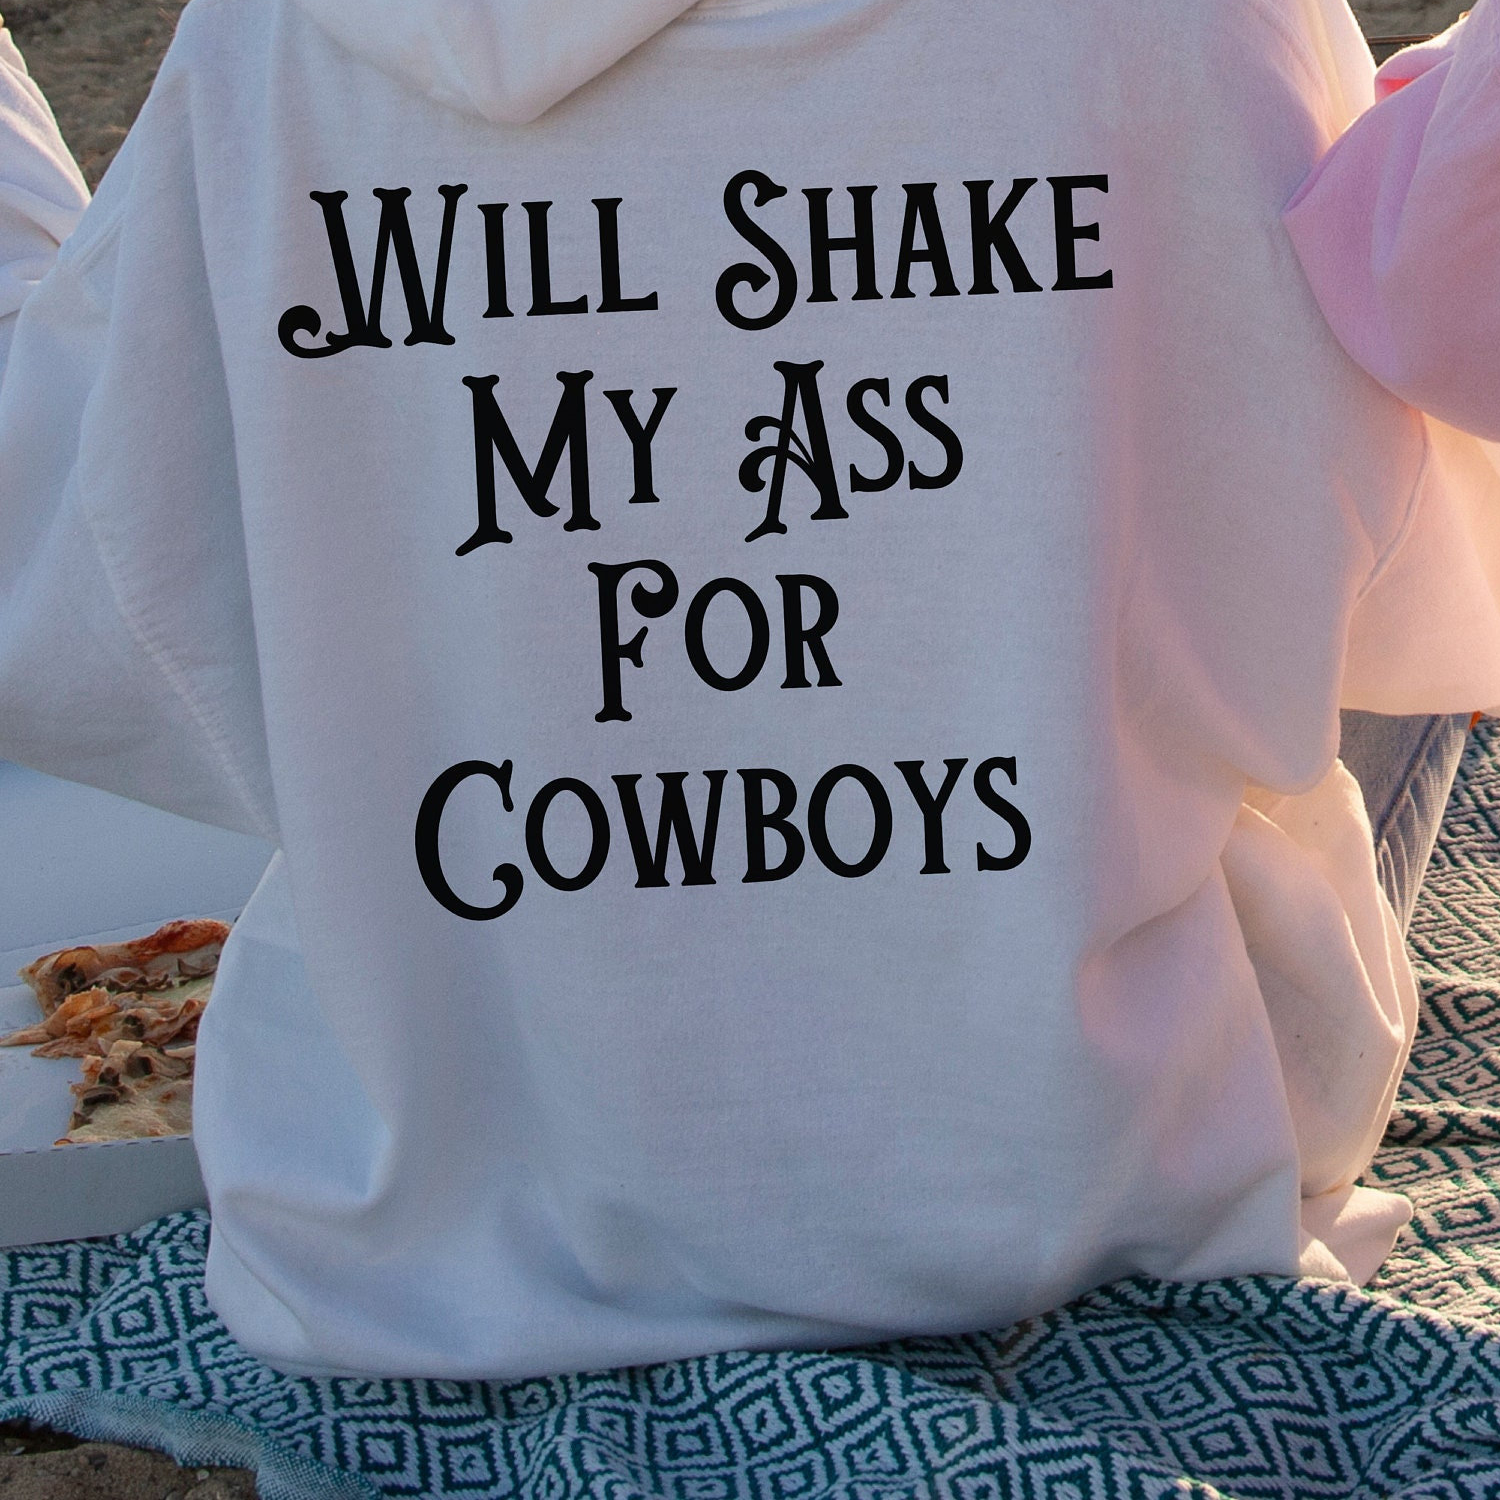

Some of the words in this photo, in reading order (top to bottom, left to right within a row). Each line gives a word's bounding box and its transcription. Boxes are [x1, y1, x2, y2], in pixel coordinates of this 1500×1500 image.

[278, 178, 659, 359] WILL
[716, 169, 1114, 331] SHAKE
[456, 369, 678, 557] MY
[738, 359, 964, 543] ASS
[587, 559, 843, 723] FOR
[414, 756, 1032, 921] COWBOYS
